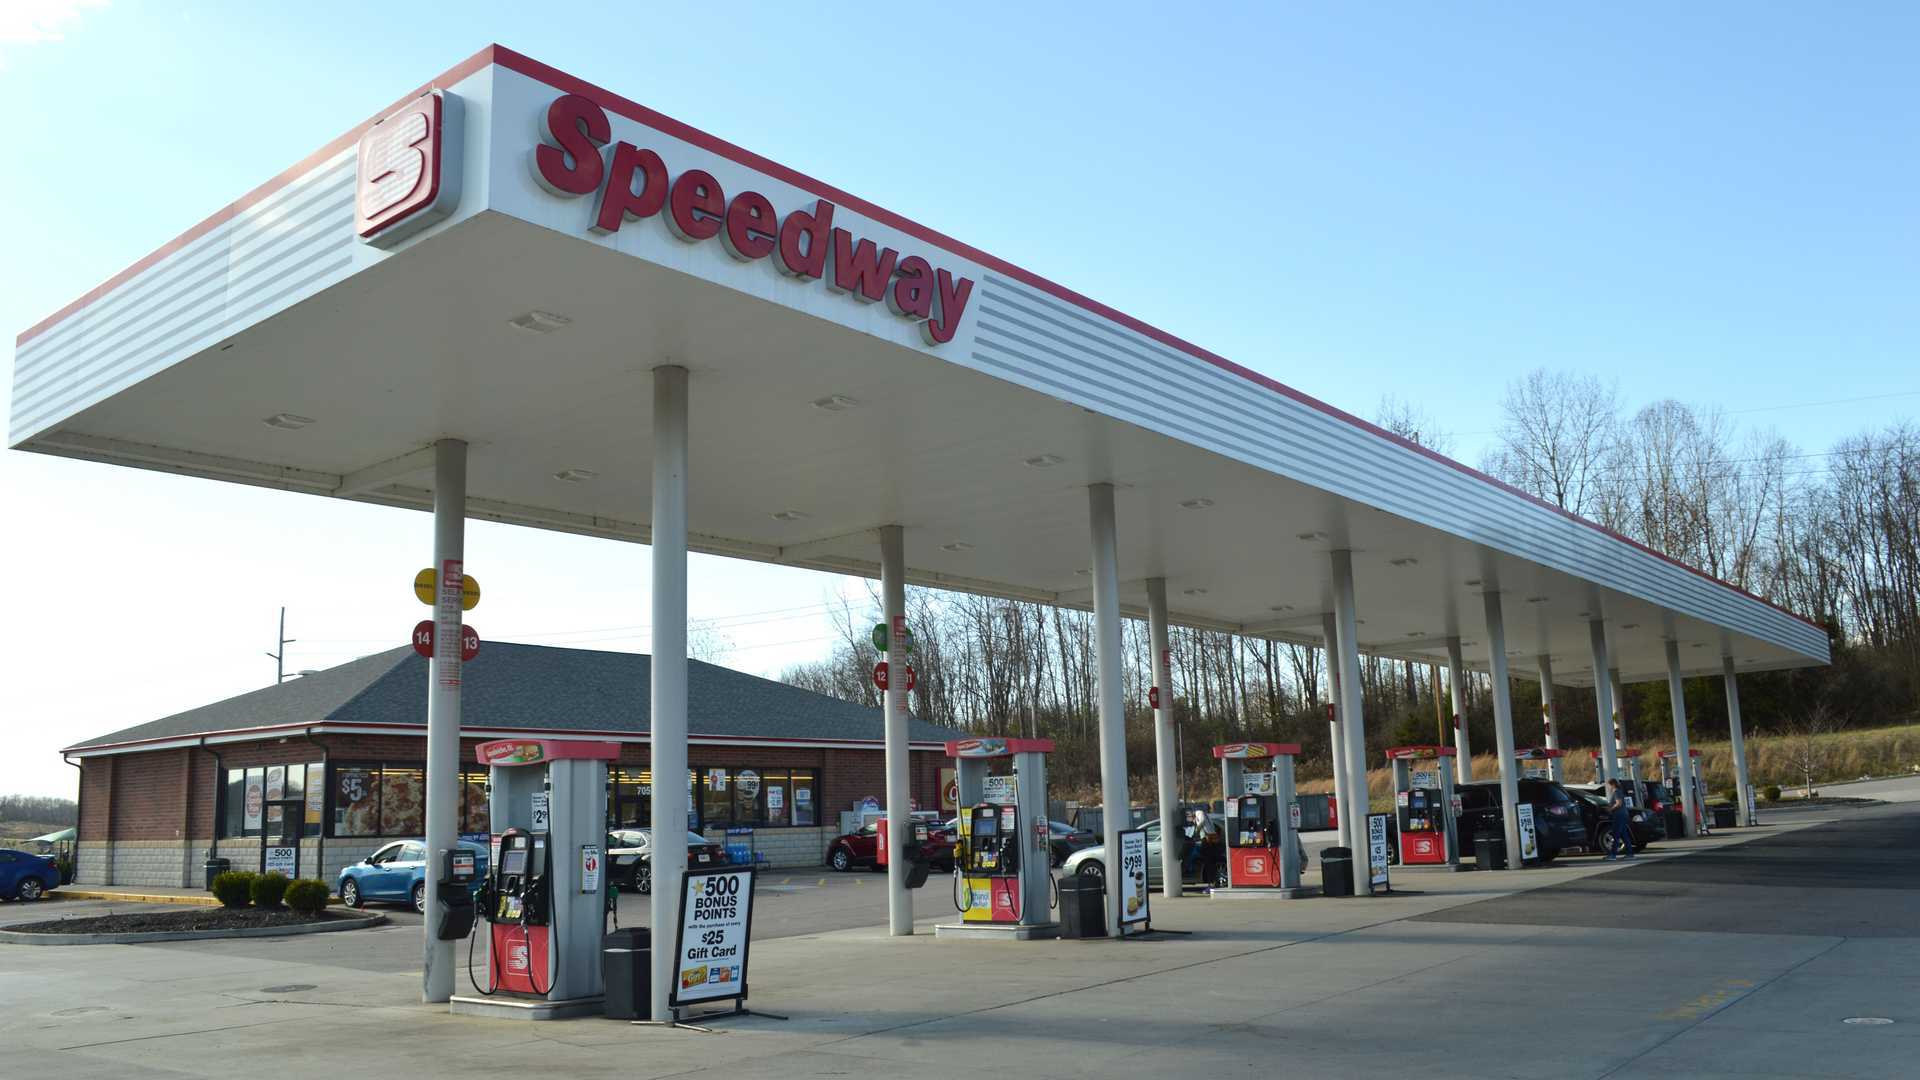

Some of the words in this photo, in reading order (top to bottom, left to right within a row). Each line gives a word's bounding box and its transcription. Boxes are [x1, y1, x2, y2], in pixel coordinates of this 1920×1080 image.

[529, 92, 974, 346] Speedway
[416, 631, 431, 645] 14
[463, 636, 478, 650] 13
[877, 671, 887, 682] 12
[274, 849, 292, 857] 500
[705, 875, 739, 896] 500
[695, 895, 737, 909] BONUS
[694, 907, 736, 921] POINTS
[702, 930, 724, 945] $25
[688, 947, 708, 960] Gift
[711, 944, 737, 958] Card
